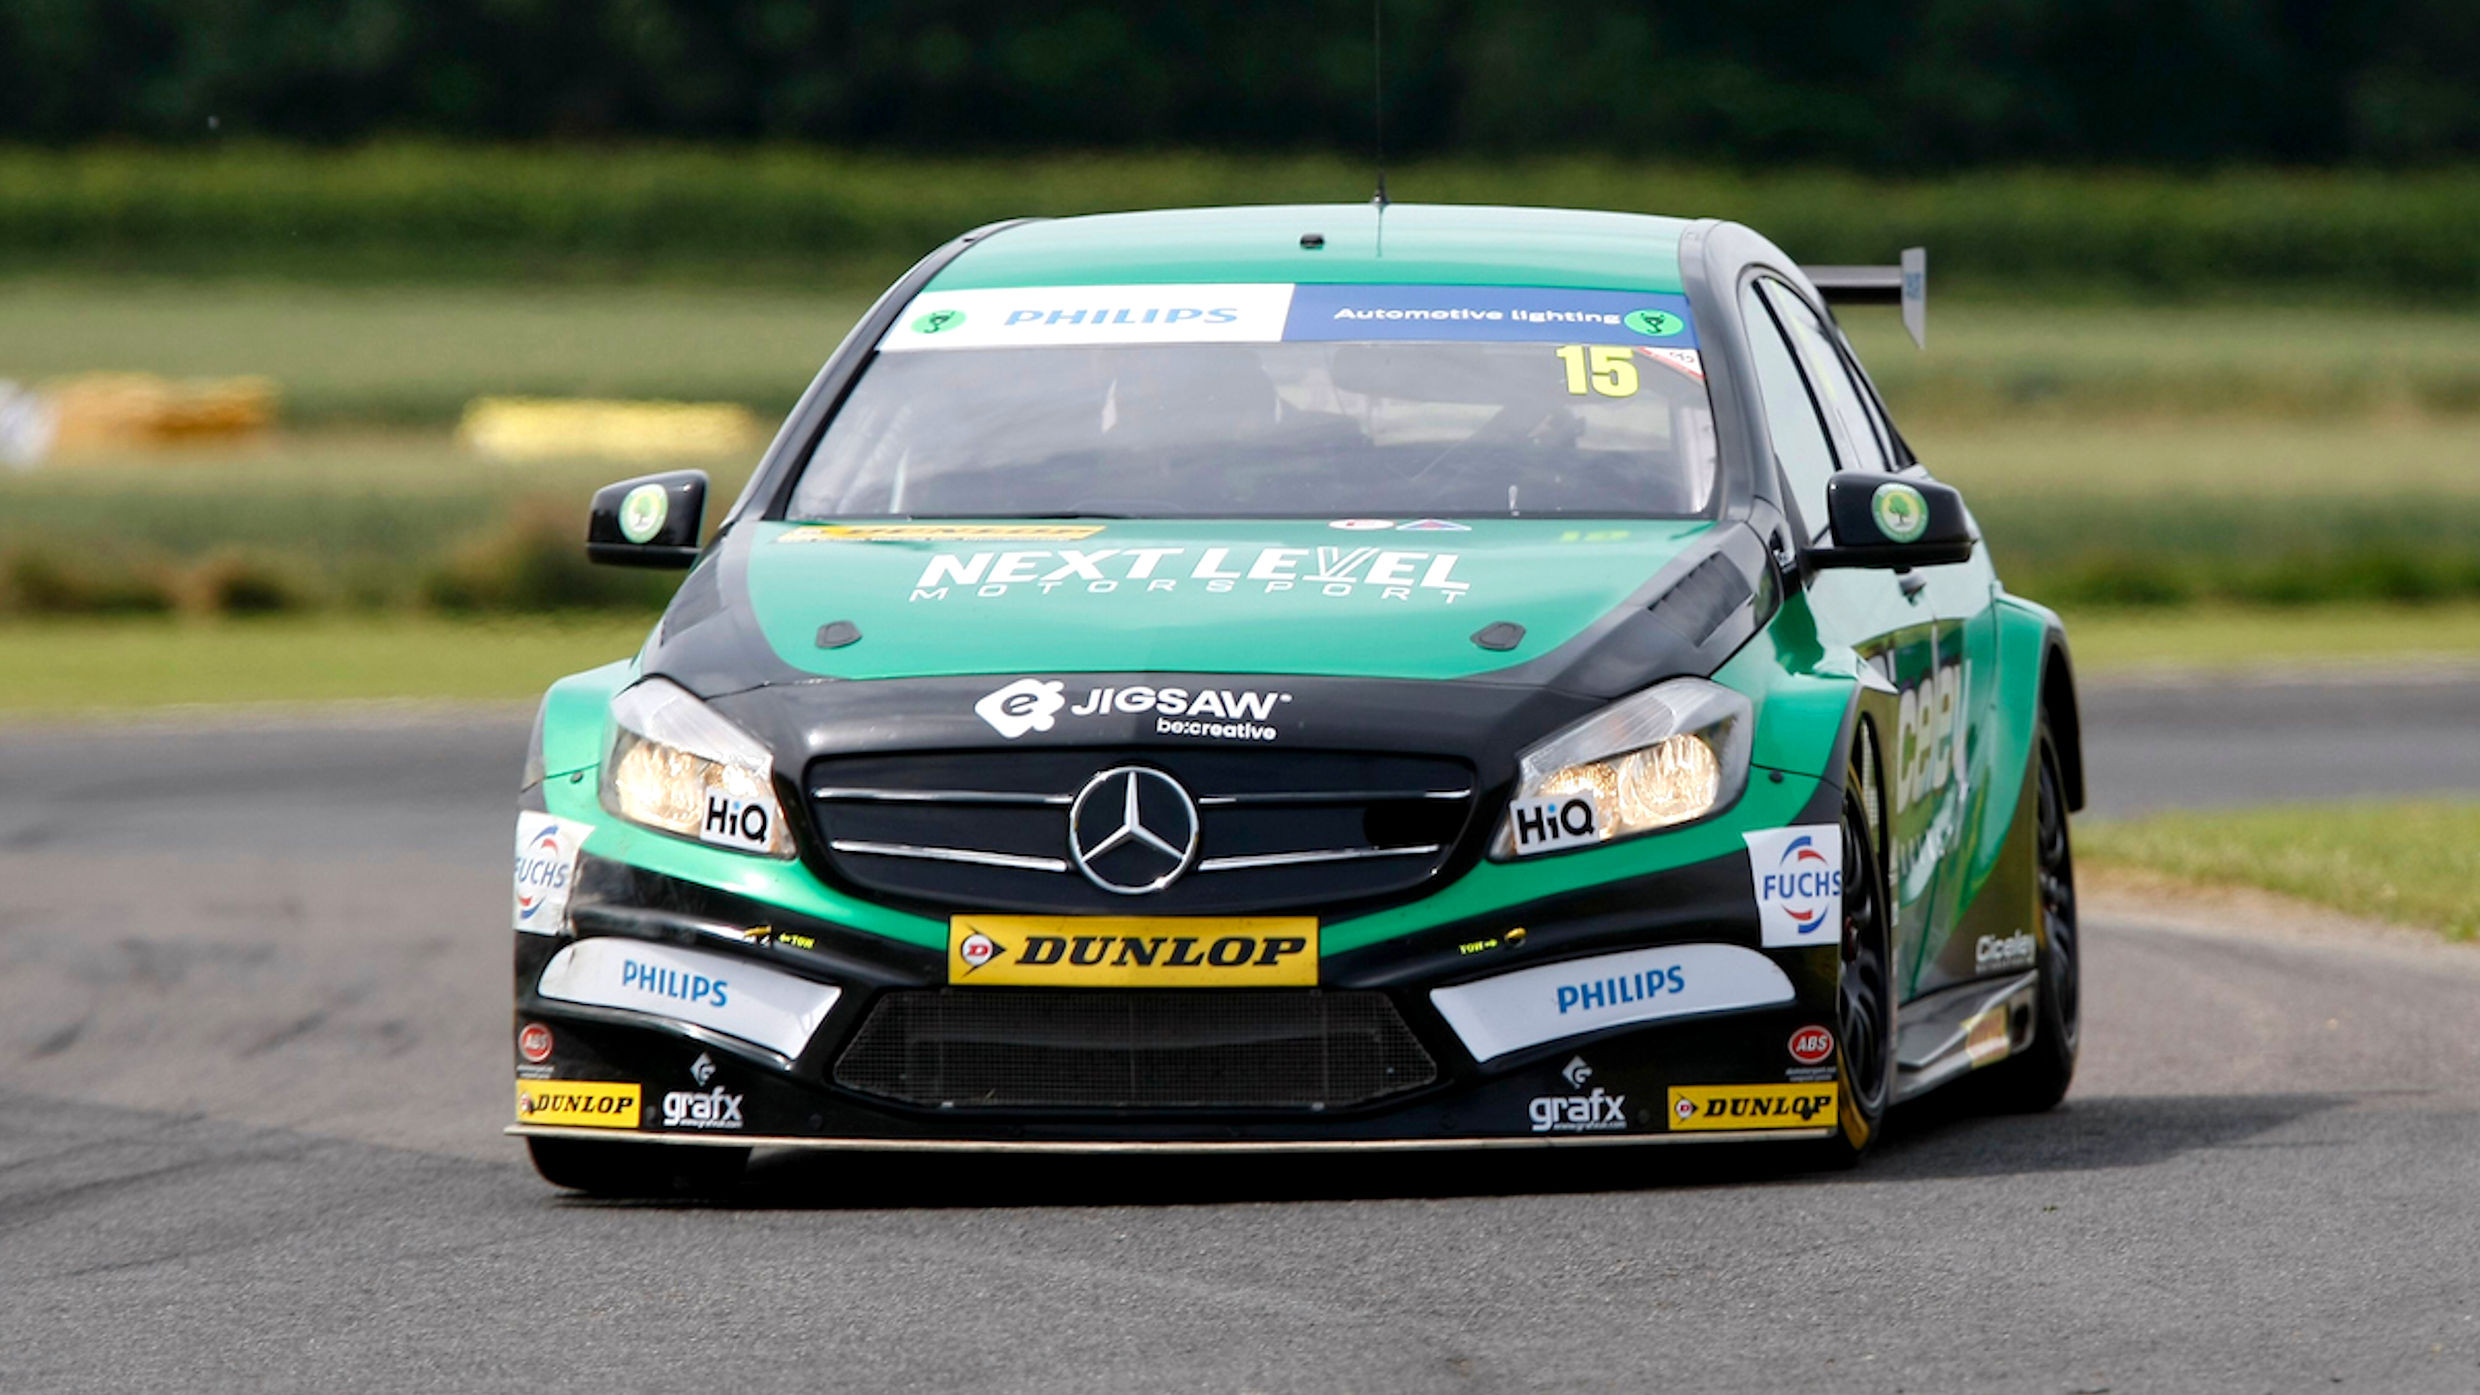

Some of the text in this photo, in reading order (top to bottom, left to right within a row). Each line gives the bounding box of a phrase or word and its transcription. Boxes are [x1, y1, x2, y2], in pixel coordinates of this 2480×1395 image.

[1004, 307, 1238, 326] PHILIPS
[1334, 307, 1623, 325] Automotive lighting
[1555, 345, 1639, 398] 15
[916, 546, 1473, 591] NEXT LEVEL
[908, 579, 1470, 605] MOTORSPORT
[1071, 686, 1279, 720] JIGSAW
[1156, 717, 1277, 741] be:creative
[706, 796, 768, 845] HiQ
[1516, 798, 1595, 846] HiQ
[1763, 870, 1842, 901] FUCHS
[1014, 936, 1307, 968] DUNLOP
[622, 958, 729, 1008] PHILIPS
[1556, 965, 1687, 1015] PHILIPS
[1796, 1034, 1829, 1052] ABS
[534, 1093, 634, 1115] DUNLOP
[662, 1085, 744, 1127] grafx
[1529, 1087, 1626, 1132] grafx
[1703, 1096, 1832, 1119] DUNLOP
